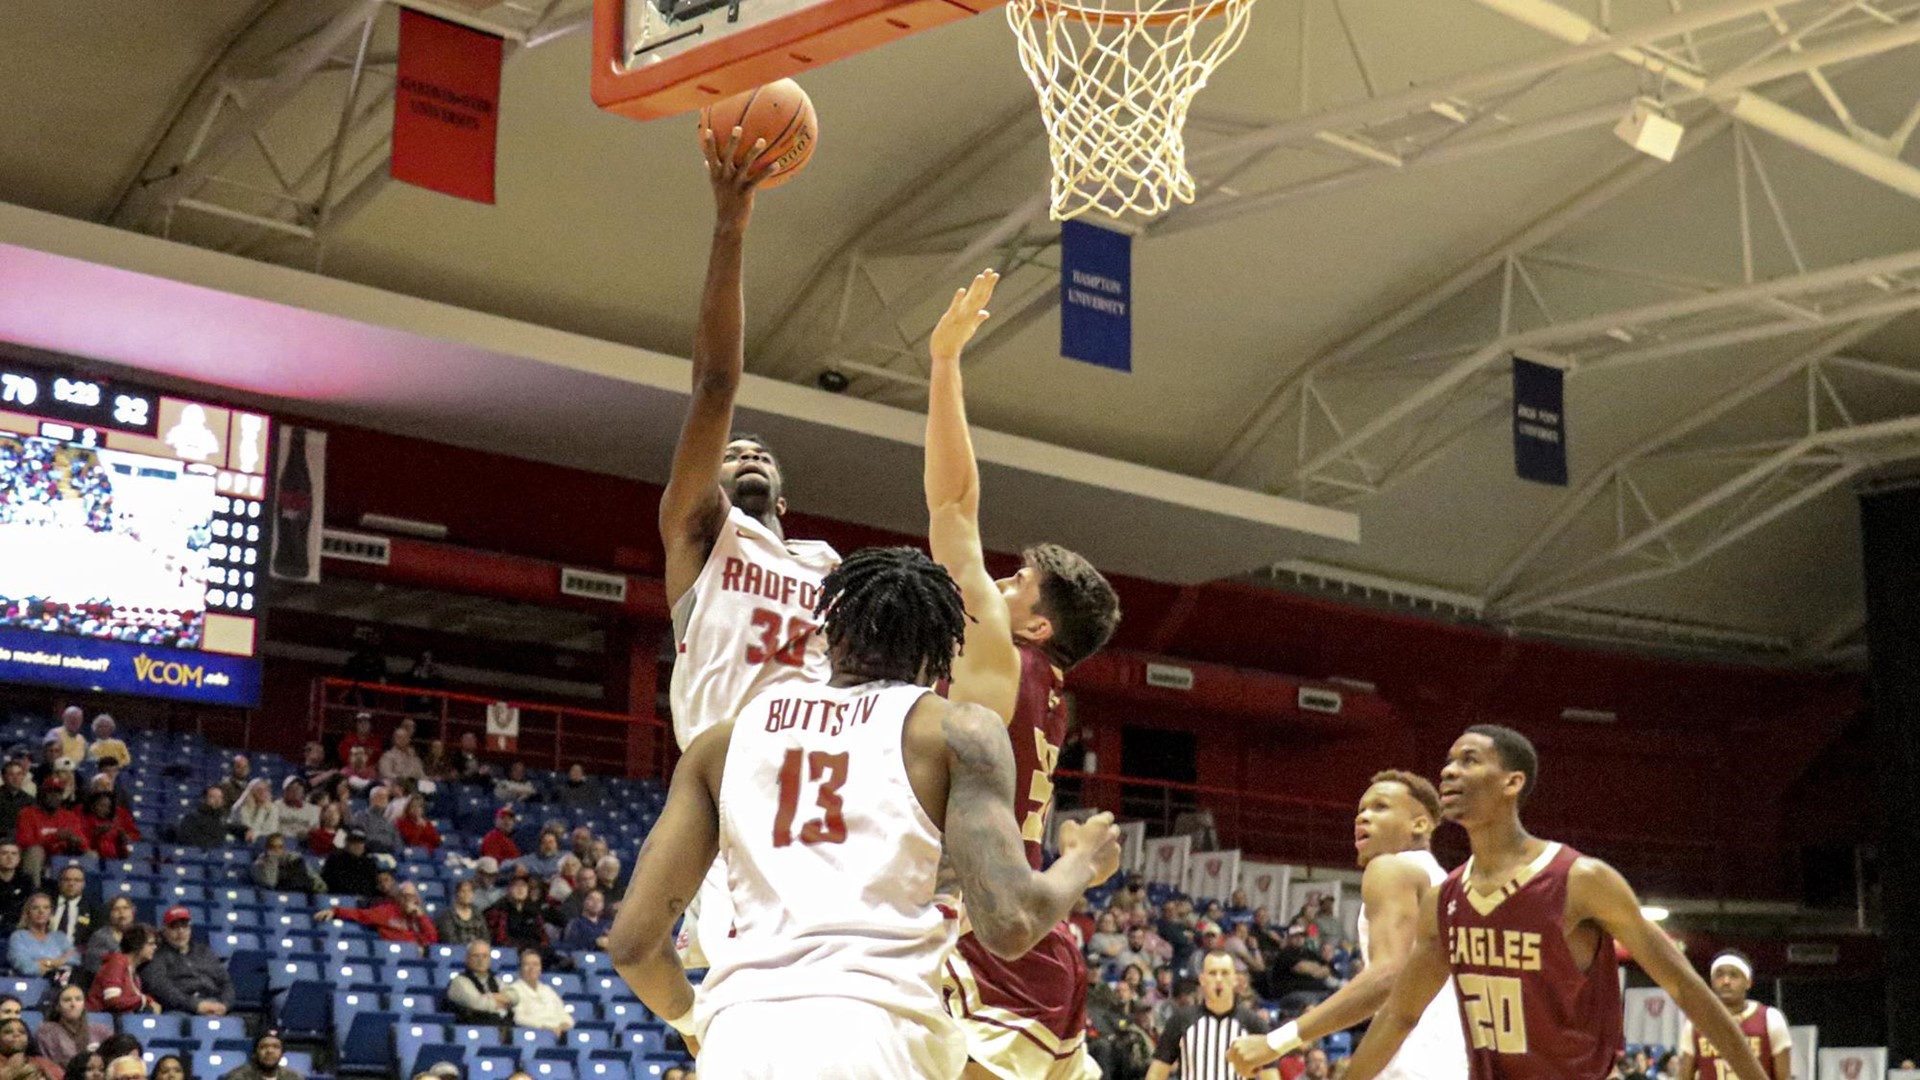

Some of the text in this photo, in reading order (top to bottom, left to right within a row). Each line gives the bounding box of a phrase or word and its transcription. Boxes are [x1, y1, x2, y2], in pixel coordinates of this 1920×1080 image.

[1068, 287, 1126, 315] UNIVERSITY
[1072, 269, 1122, 295] HAMPTON
[2, 373, 38, 406] 70
[722, 556, 825, 612] RADFO
[13, 650, 62, 667] medical
[765, 693, 880, 737] BUTTS IV
[772, 747, 849, 848] 13
[1457, 974, 1527, 1054] 20
